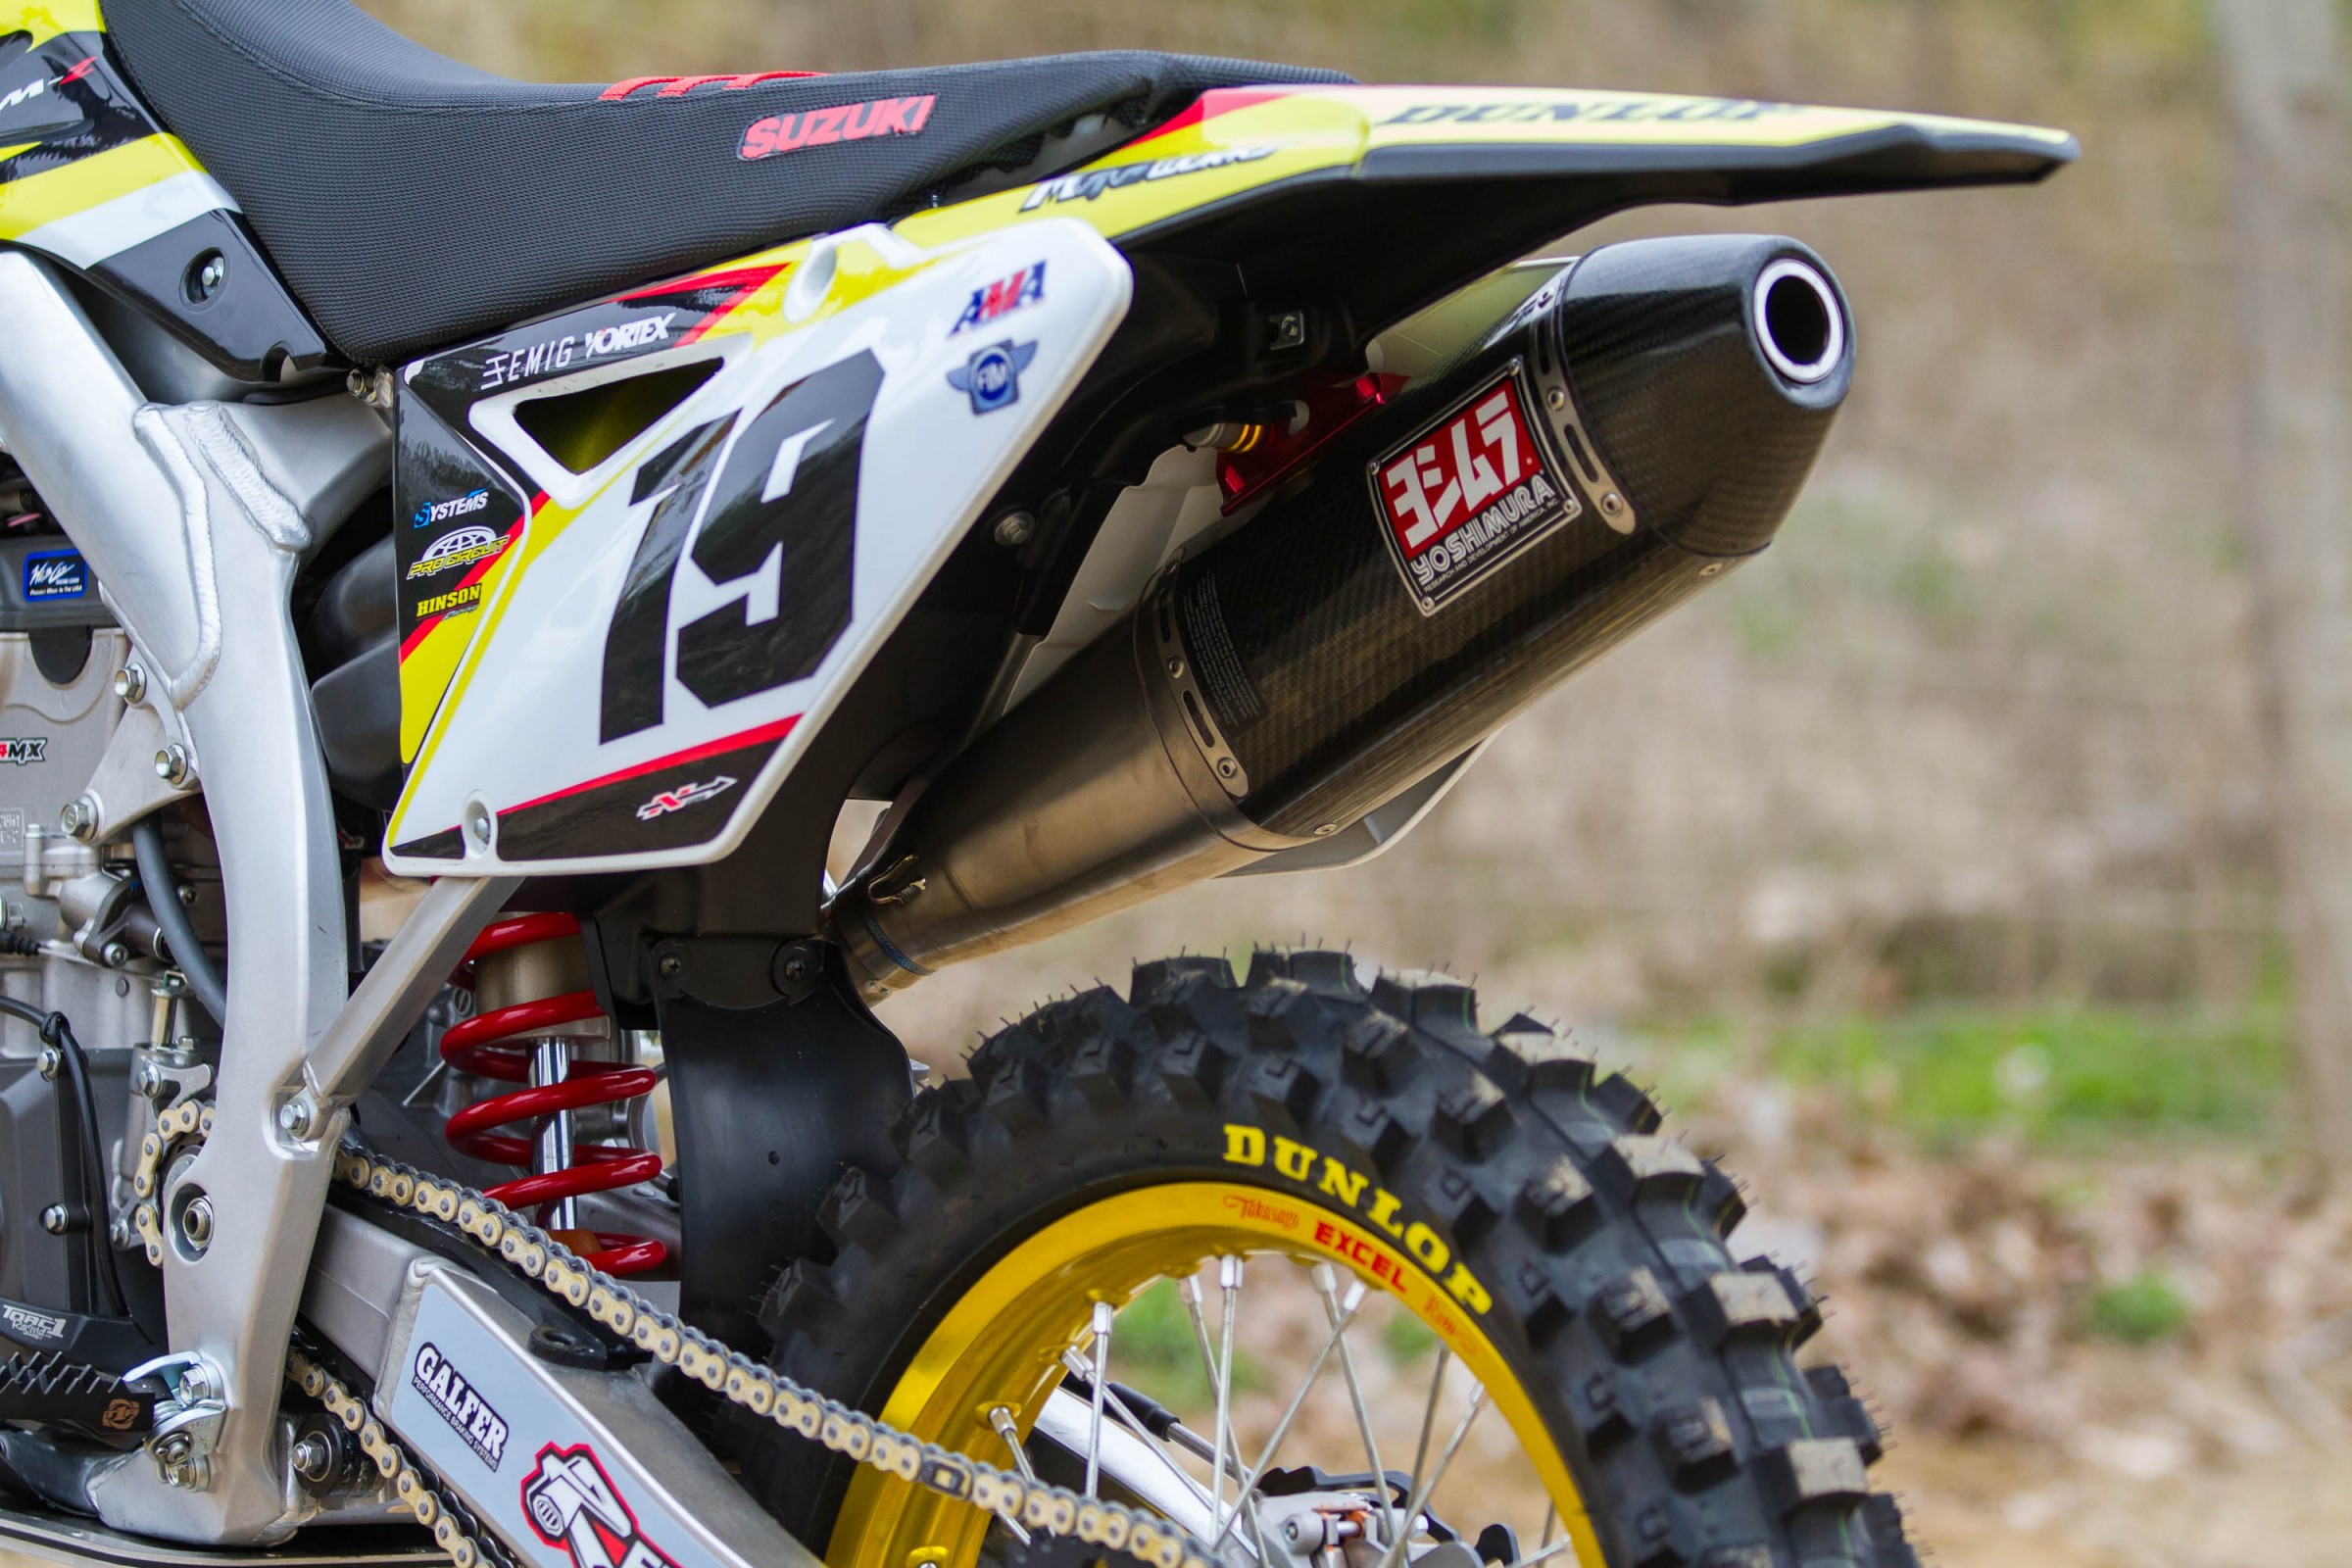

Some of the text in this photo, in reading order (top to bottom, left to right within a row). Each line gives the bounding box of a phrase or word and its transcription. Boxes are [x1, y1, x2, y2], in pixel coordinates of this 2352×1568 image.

[740, 94, 936, 160] SUZUKI
[585, 313, 676, 359] VORTEX
[949, 260, 1047, 337] AMA
[1386, 390, 1521, 550] ヨシムラ
[414, 490, 489, 528] SYSTEMS
[600, 348, 886, 745] 19
[1410, 474, 1556, 586] YOSHIMURA
[407, 536, 509, 579] PRO CIRCUIT
[416, 584, 481, 617] HINSON
[1223, 1123, 1493, 1315] DUNLOP
[1313, 1221, 1407, 1294] EXCEL
[416, 1344, 509, 1461] GALFER
